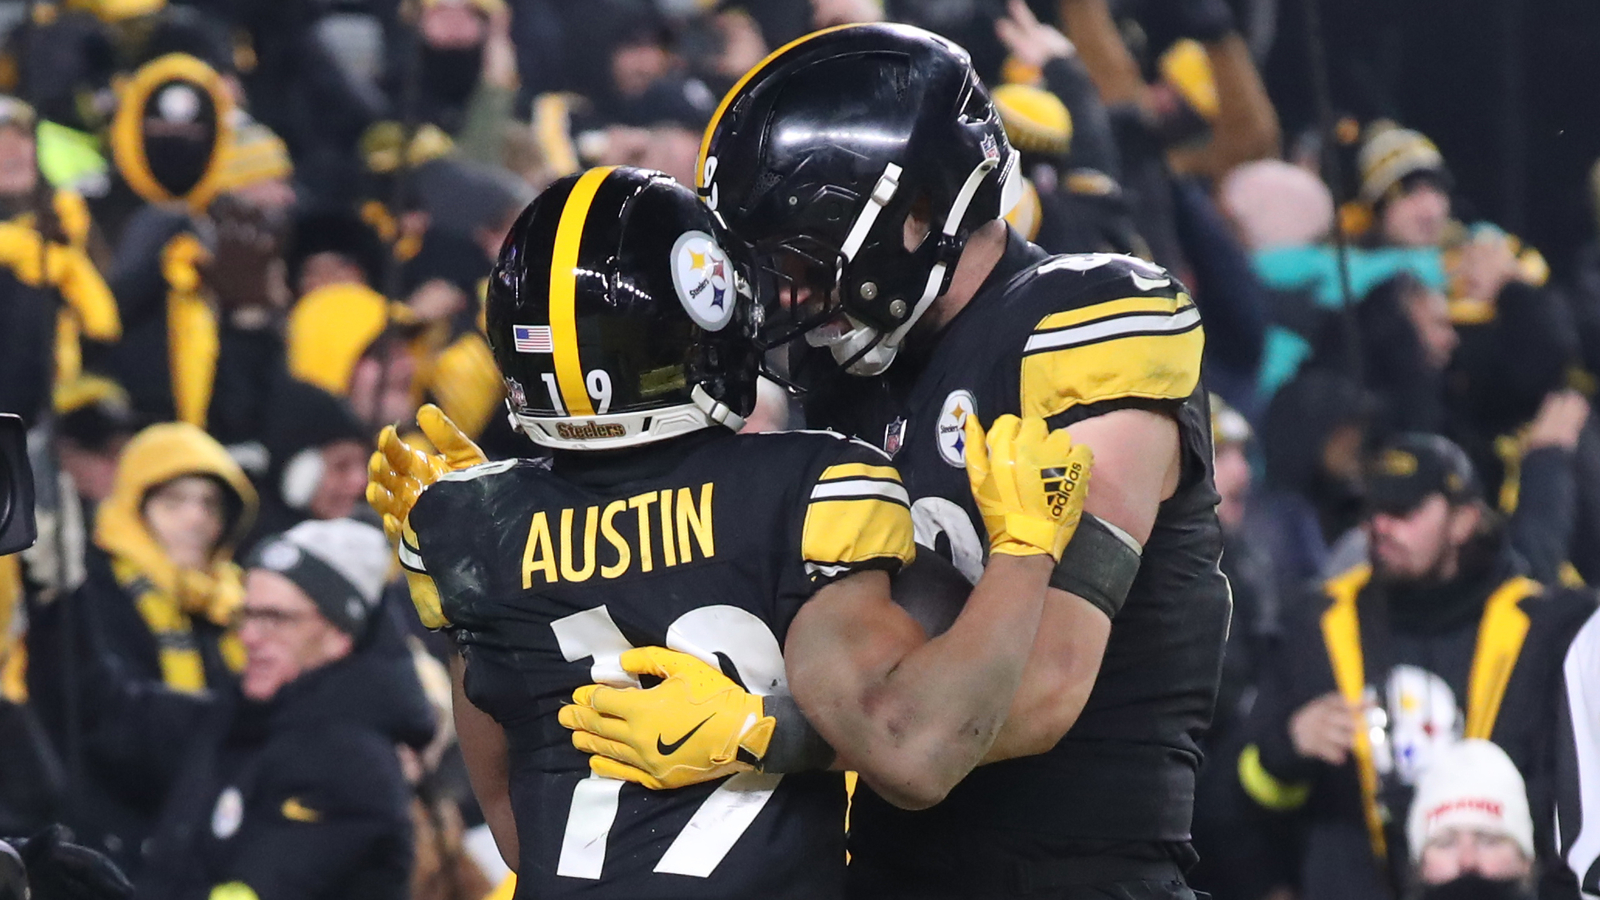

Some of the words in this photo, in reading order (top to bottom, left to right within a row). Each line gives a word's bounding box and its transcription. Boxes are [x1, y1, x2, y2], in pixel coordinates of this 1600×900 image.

[689, 278, 710, 299] Steelers
[540, 369, 612, 416] 19
[555, 421, 626, 439] Steelers
[940, 423, 960, 435] Steelers
[1052, 462, 1082, 517] adidas
[521, 482, 715, 590] AUSTIN
